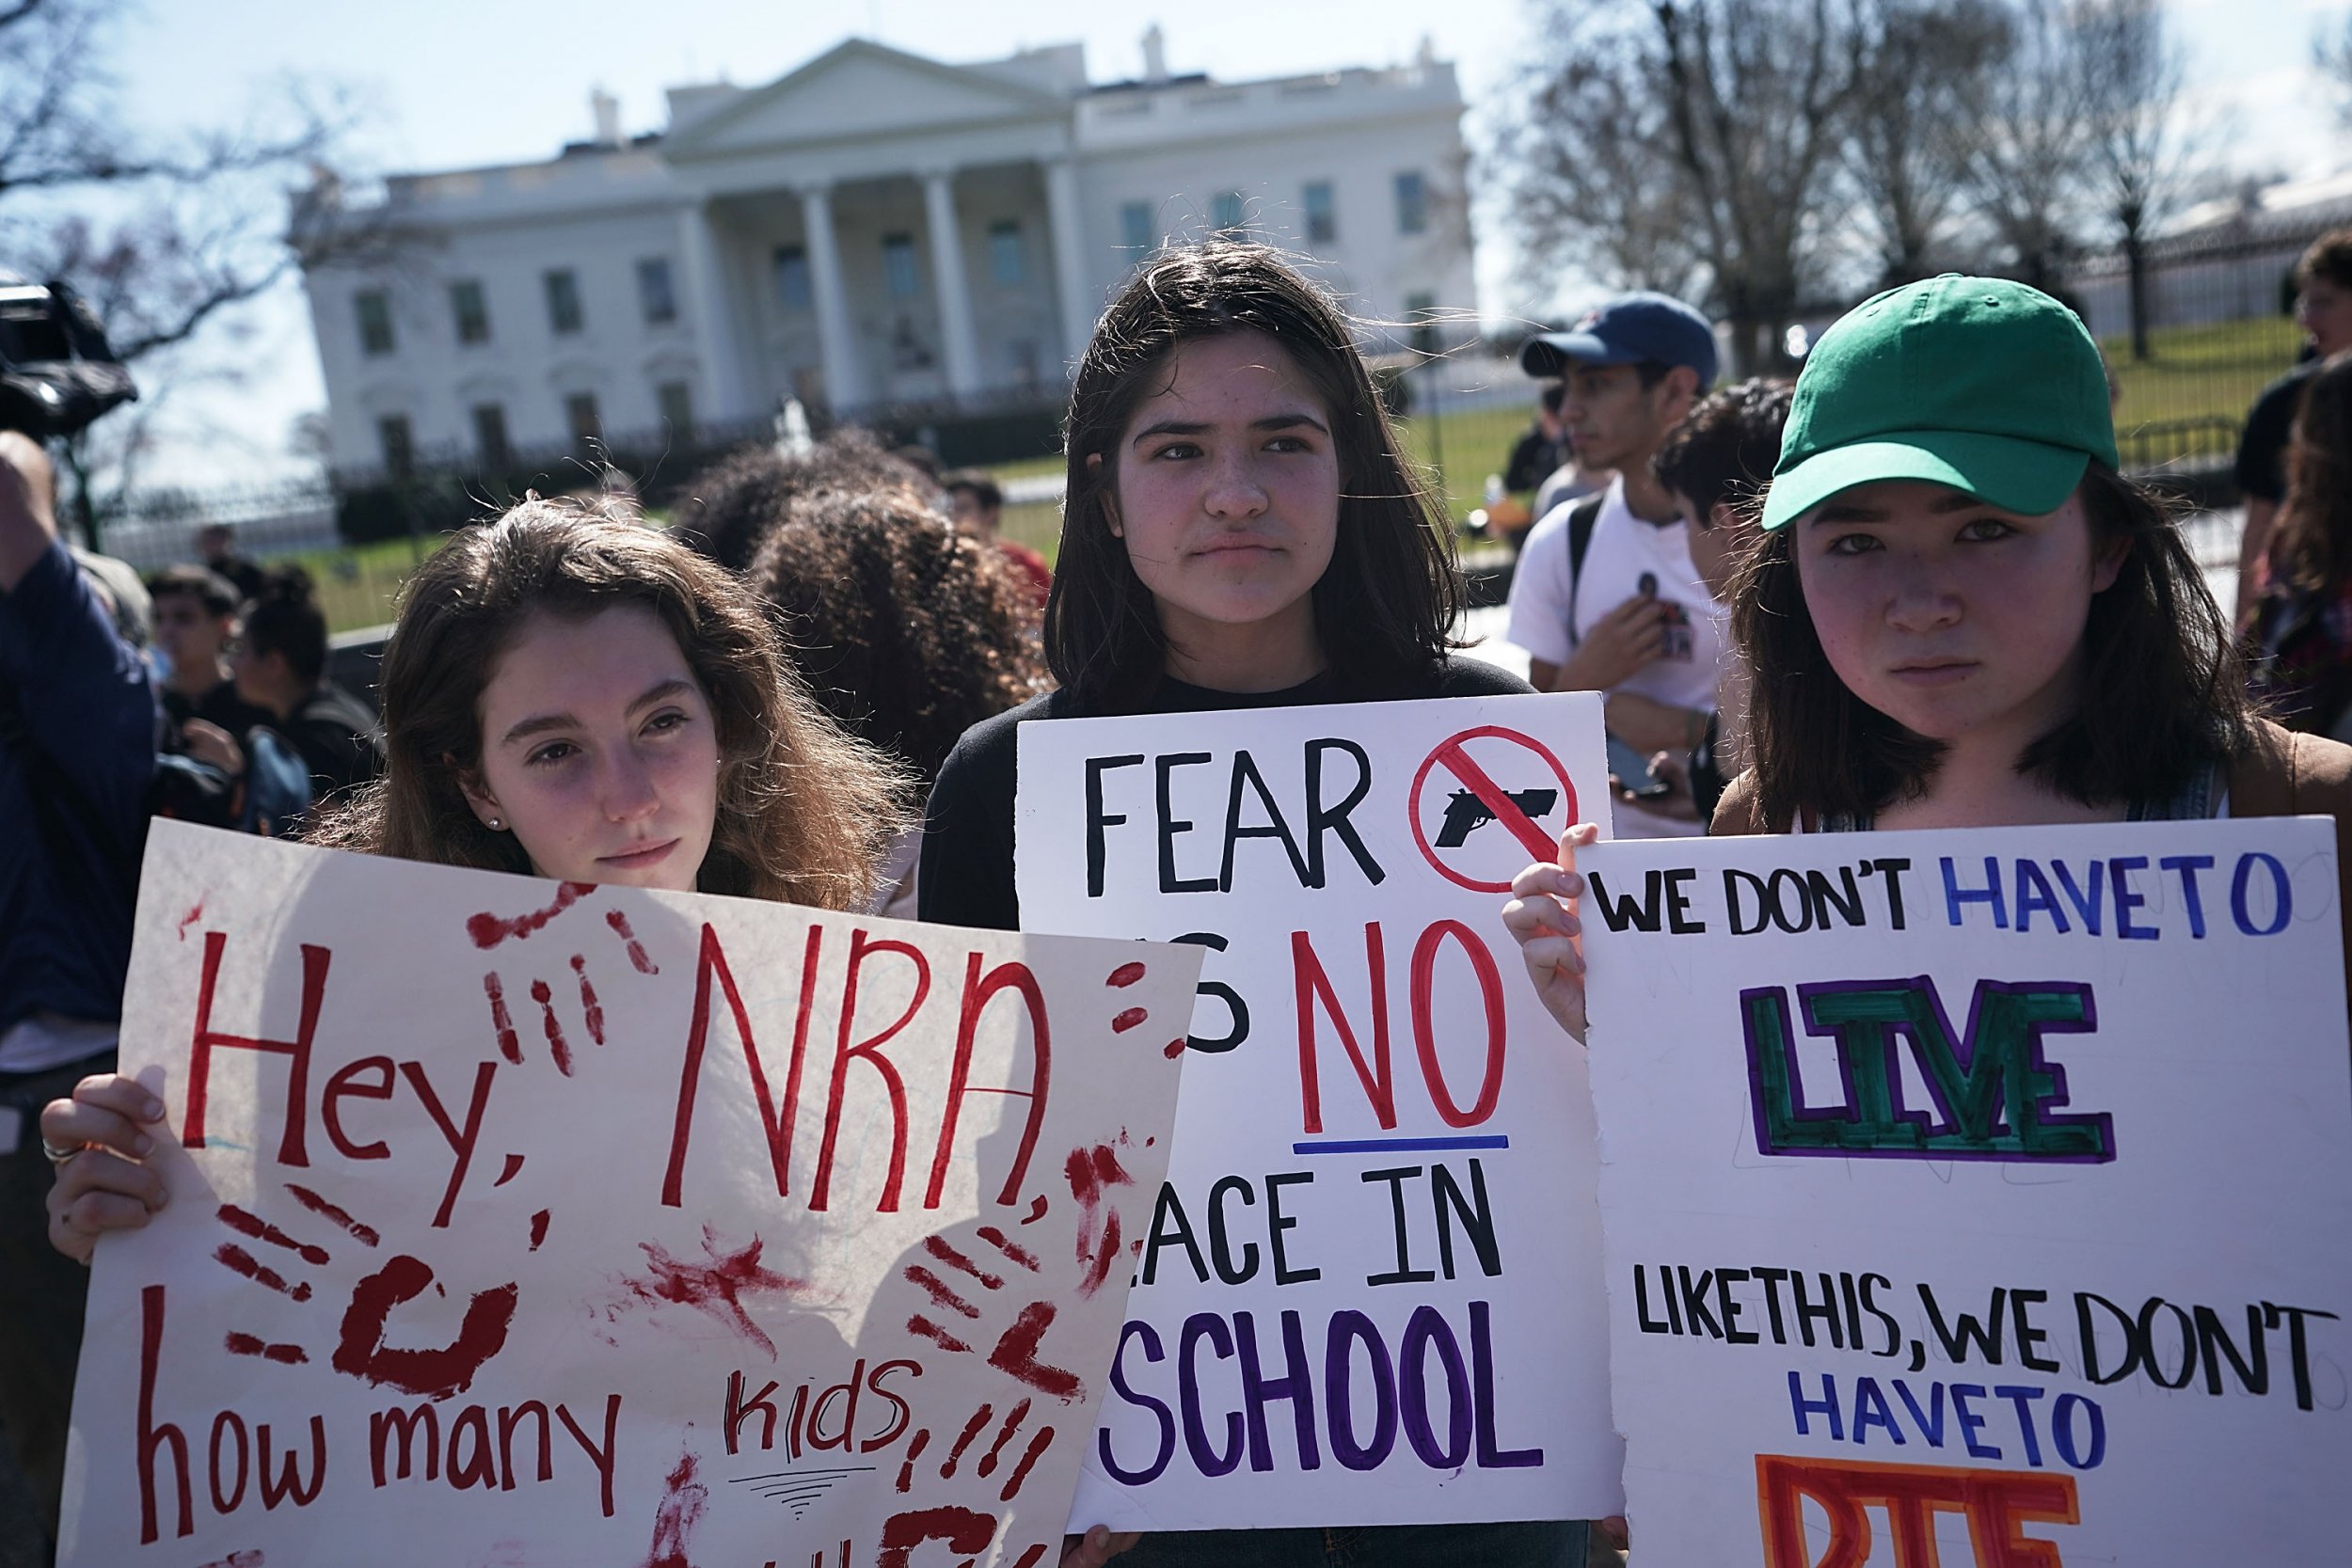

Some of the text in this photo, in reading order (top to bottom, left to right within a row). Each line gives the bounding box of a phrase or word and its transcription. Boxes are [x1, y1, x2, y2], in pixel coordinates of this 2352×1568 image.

[1085, 737, 1385, 897] FEAR
[1588, 866, 1707, 935] WE
[1722, 857, 1912, 936] DON'T
[183, 924, 1051, 1228] Hey, NRA,
[1135, 919, 1506, 1133] S NO
[1740, 974, 2117, 1164] LIVE
[1131, 1158, 1502, 1287] ACE IN
[137, 1285, 326, 1544] how
[370, 1393, 622, 1517] many
[1099, 1301, 1545, 1486] SCHOOL
[1915, 1283, 2061, 1373] WE
[2074, 1291, 2342, 1411] DON'T
[1755, 1454, 2081, 1568] DIE
